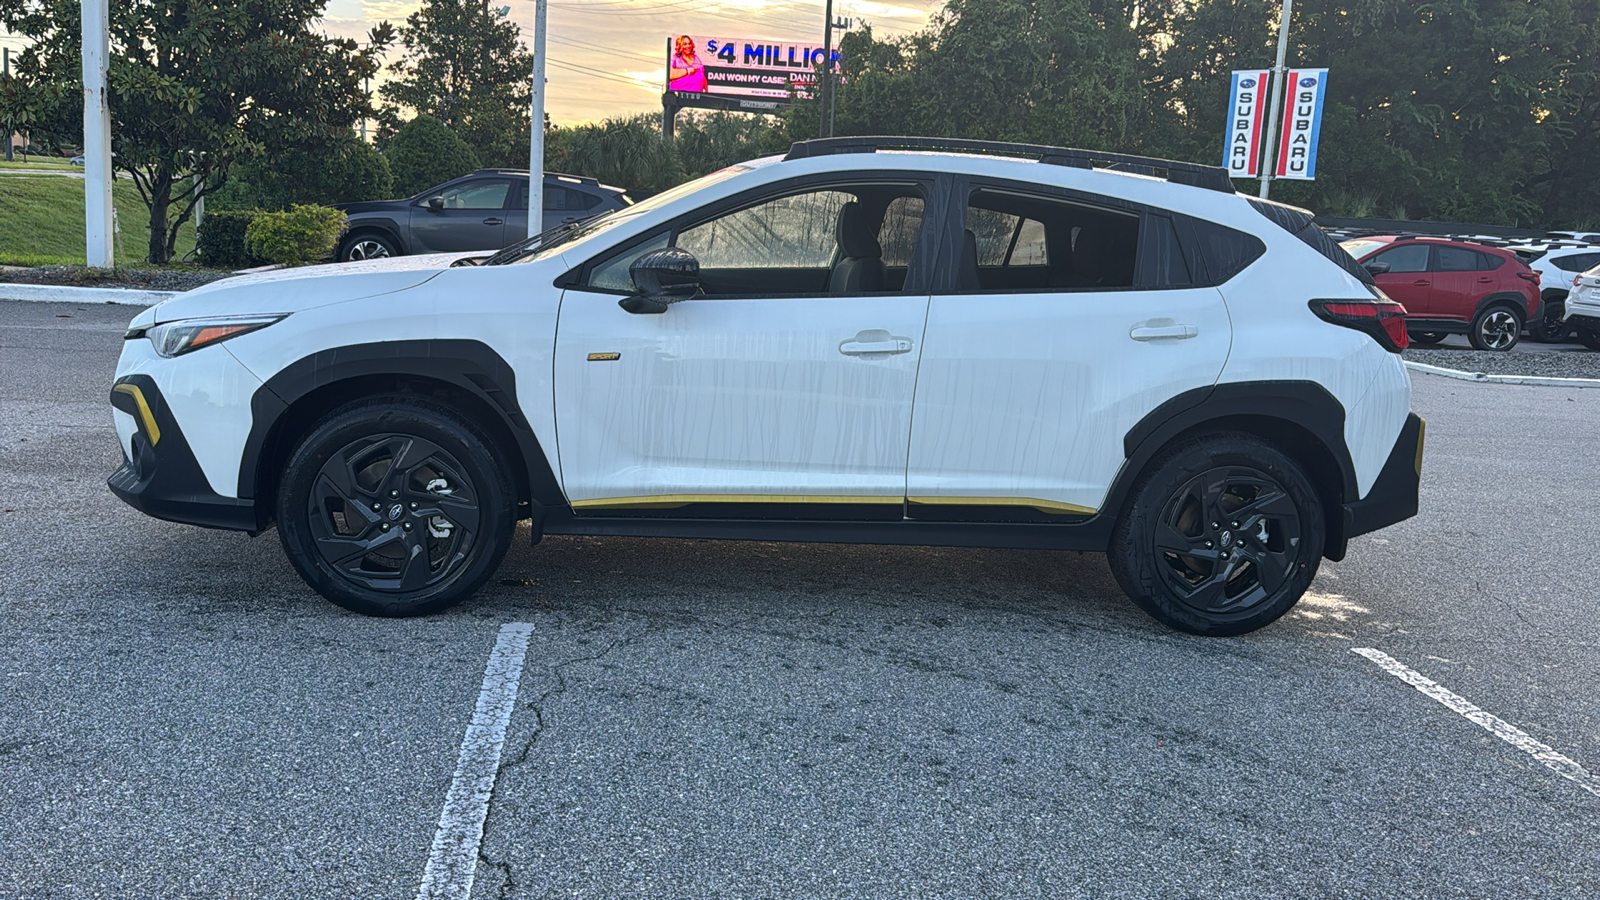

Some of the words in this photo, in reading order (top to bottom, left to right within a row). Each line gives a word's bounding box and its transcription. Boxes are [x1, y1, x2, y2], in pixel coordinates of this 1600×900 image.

[707, 40, 737, 65] $4
[707, 72, 726, 81] DAN
[726, 73, 748, 83] WON
[748, 75, 761, 84] MY
[1231, 92, 1253, 170] SUBARU
[1290, 91, 1314, 172] SUBARU
